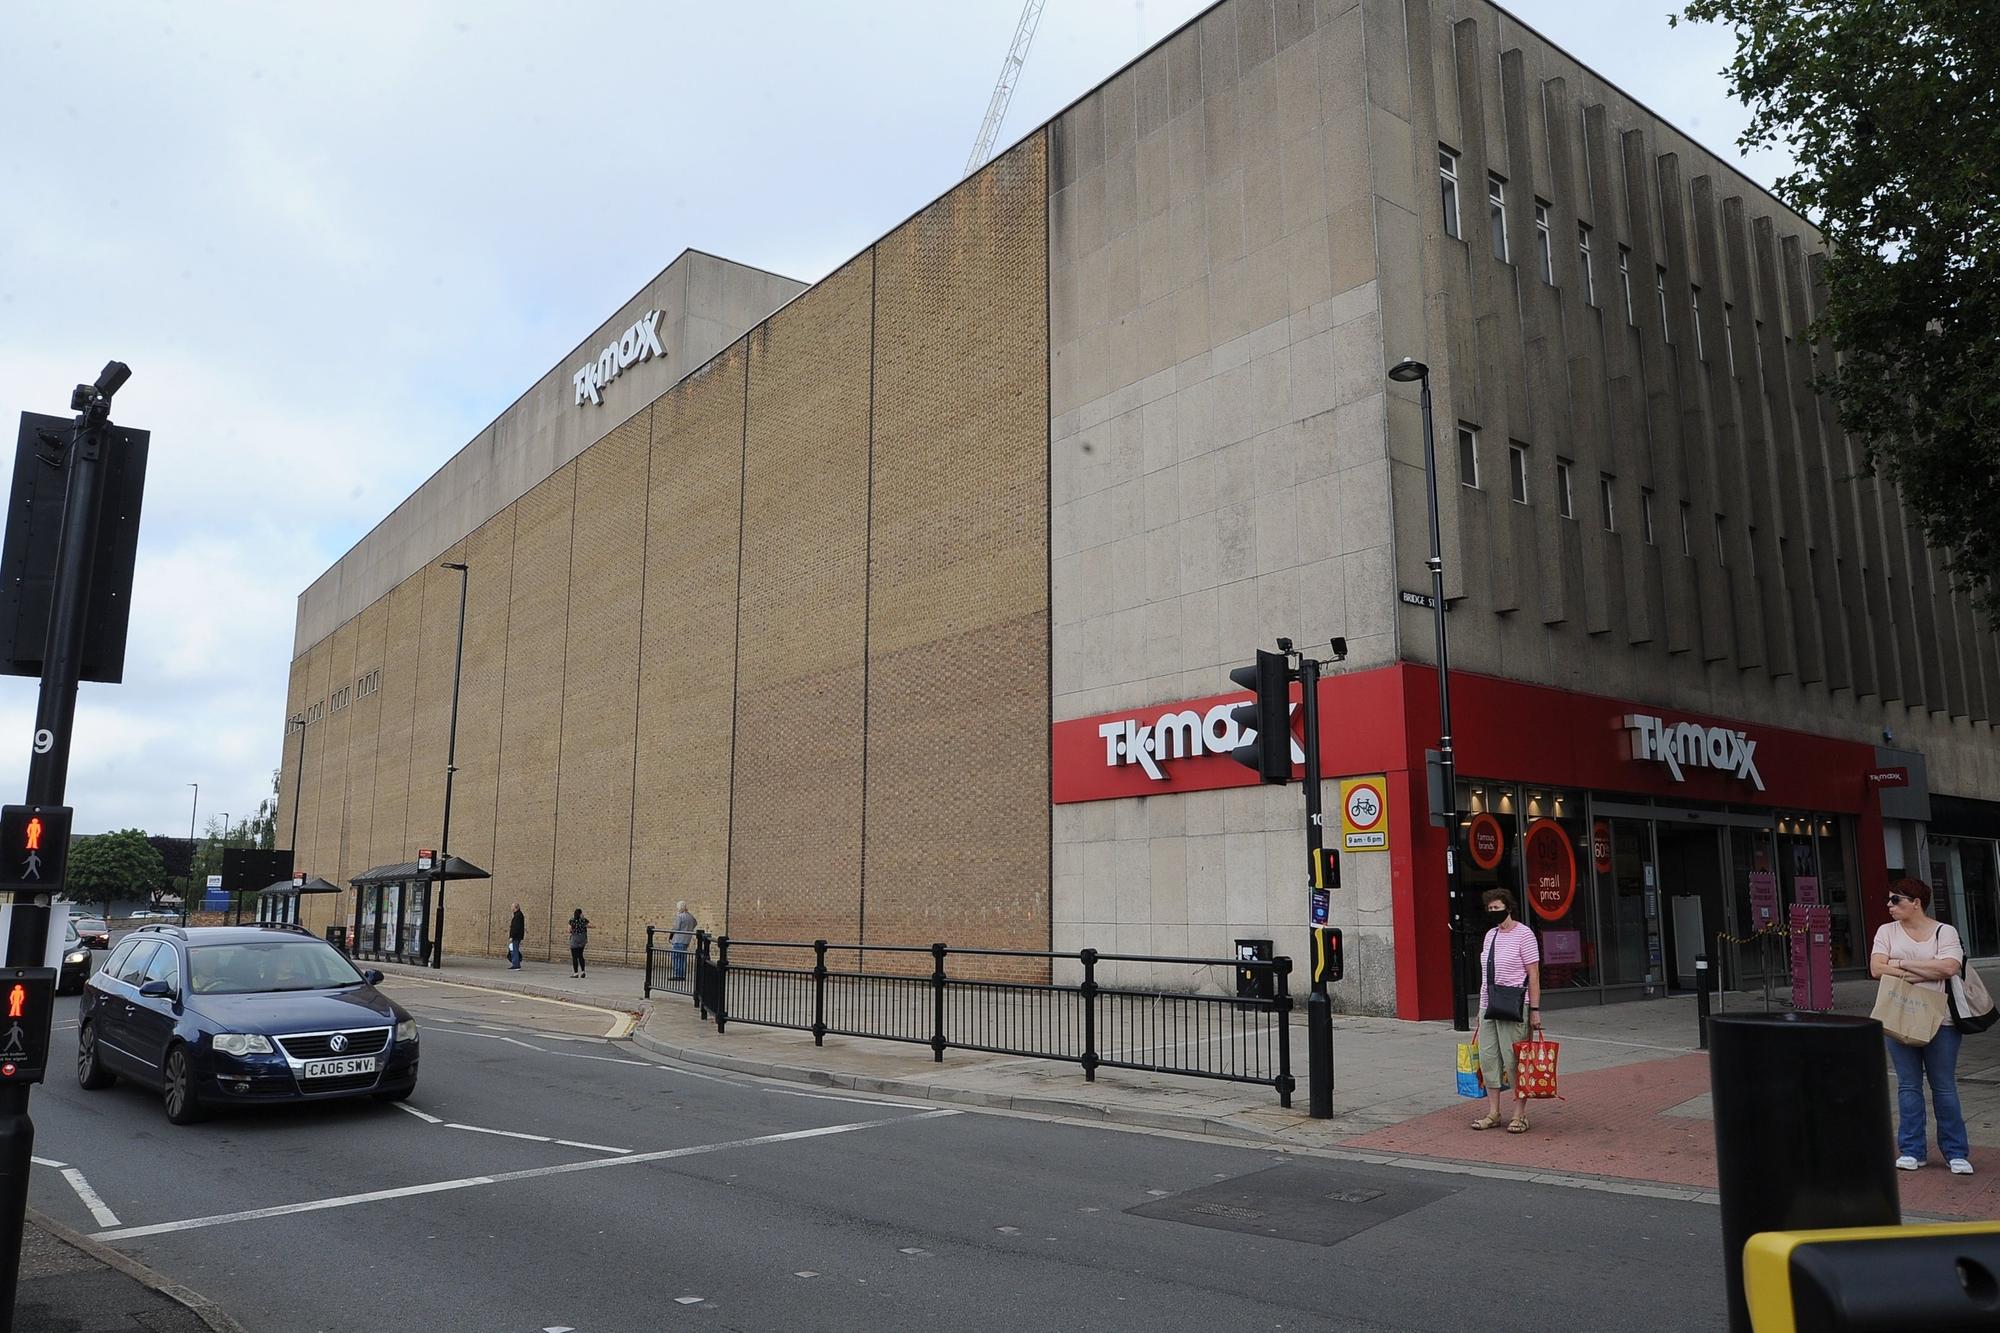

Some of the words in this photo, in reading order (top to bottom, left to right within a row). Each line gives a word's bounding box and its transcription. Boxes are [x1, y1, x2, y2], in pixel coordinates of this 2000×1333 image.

[1403, 592, 1425, 605] BRIDGE
[34, 729, 54, 754] 9
[1477, 832, 1495, 842] famous
[1478, 842, 1495, 850] brands
[1539, 874, 1560, 888] small
[1540, 887, 1561, 902] prices
[310, 1062, 344, 1076] CA06
[347, 1060, 370, 1073] SWV
